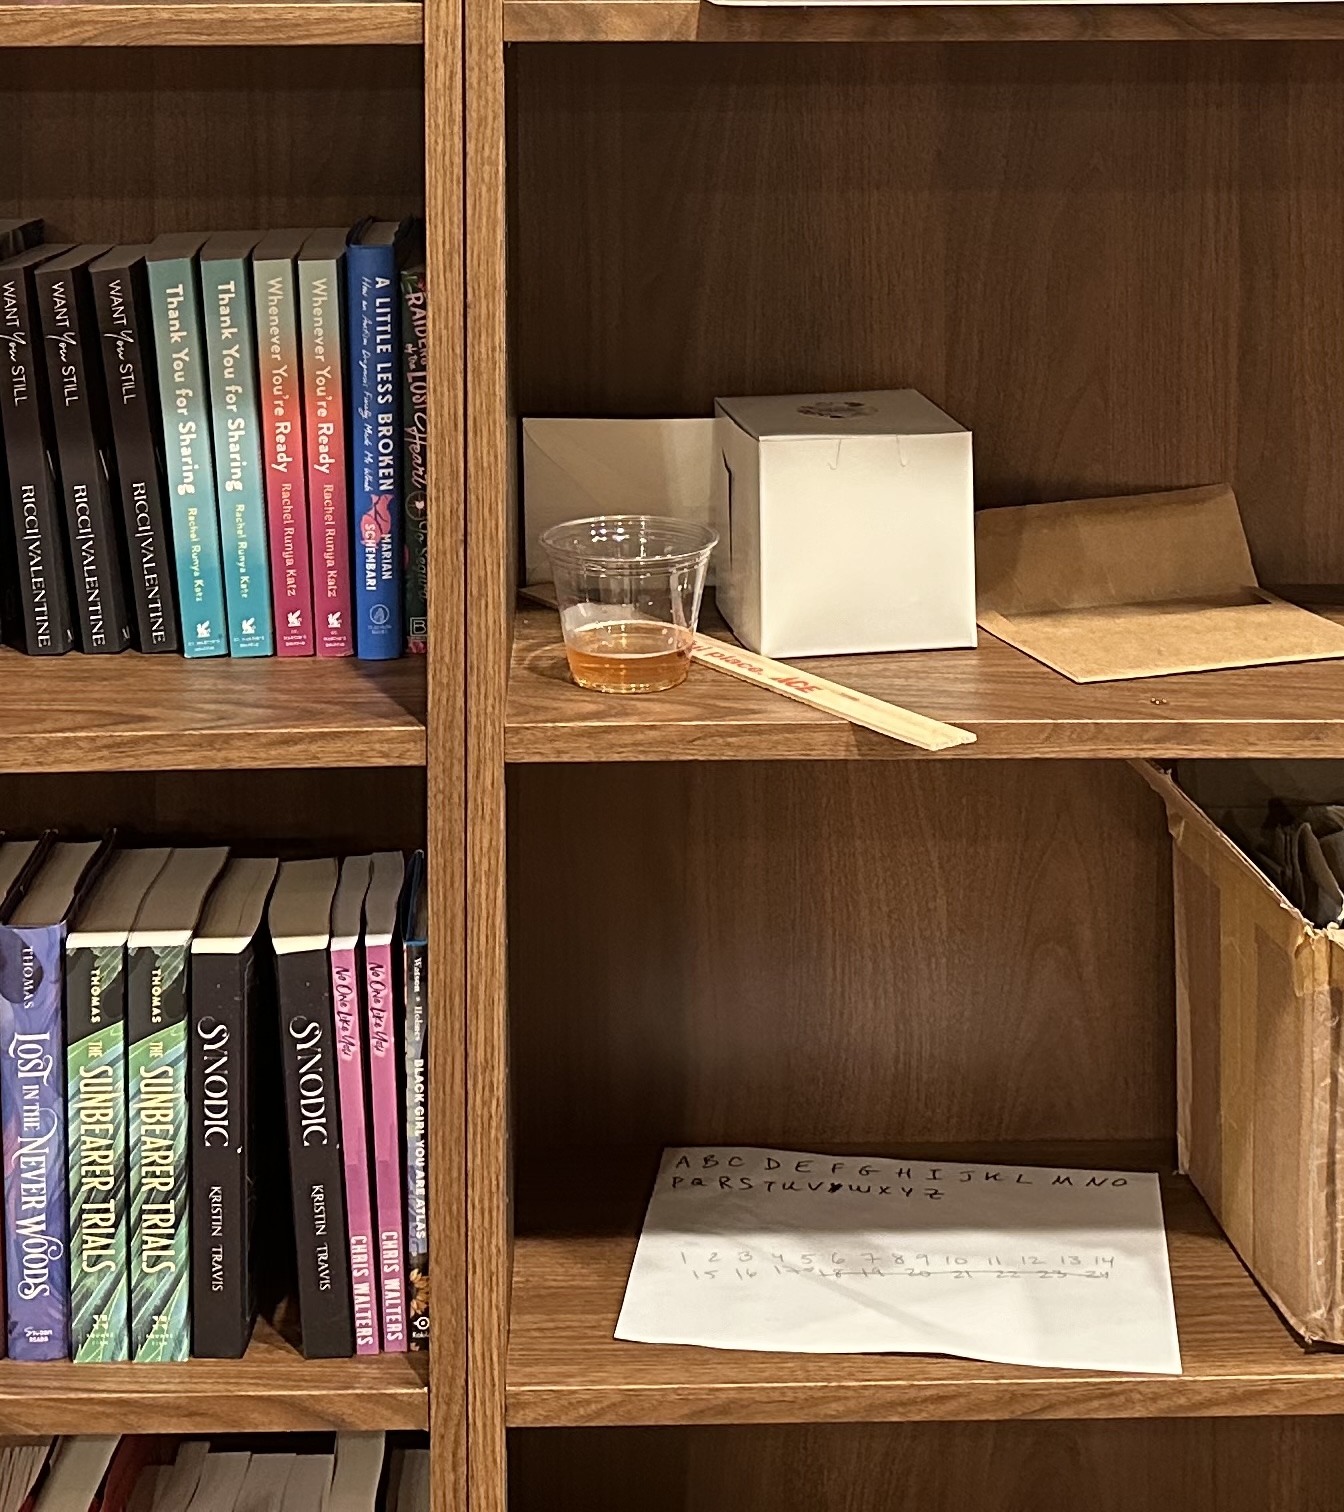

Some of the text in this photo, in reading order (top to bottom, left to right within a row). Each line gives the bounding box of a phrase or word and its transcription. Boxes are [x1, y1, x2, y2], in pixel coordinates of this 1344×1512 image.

[165, 284, 198, 495] Thank You for Sharing
[375, 277, 394, 491] A LITTLE LESS BROKEN
[197, 1016, 230, 1148] SYNODIC
[209, 1185, 224, 1292] KRISTIN TRAVIS
[381, 1231, 404, 1342] CHRIS WALTERS
